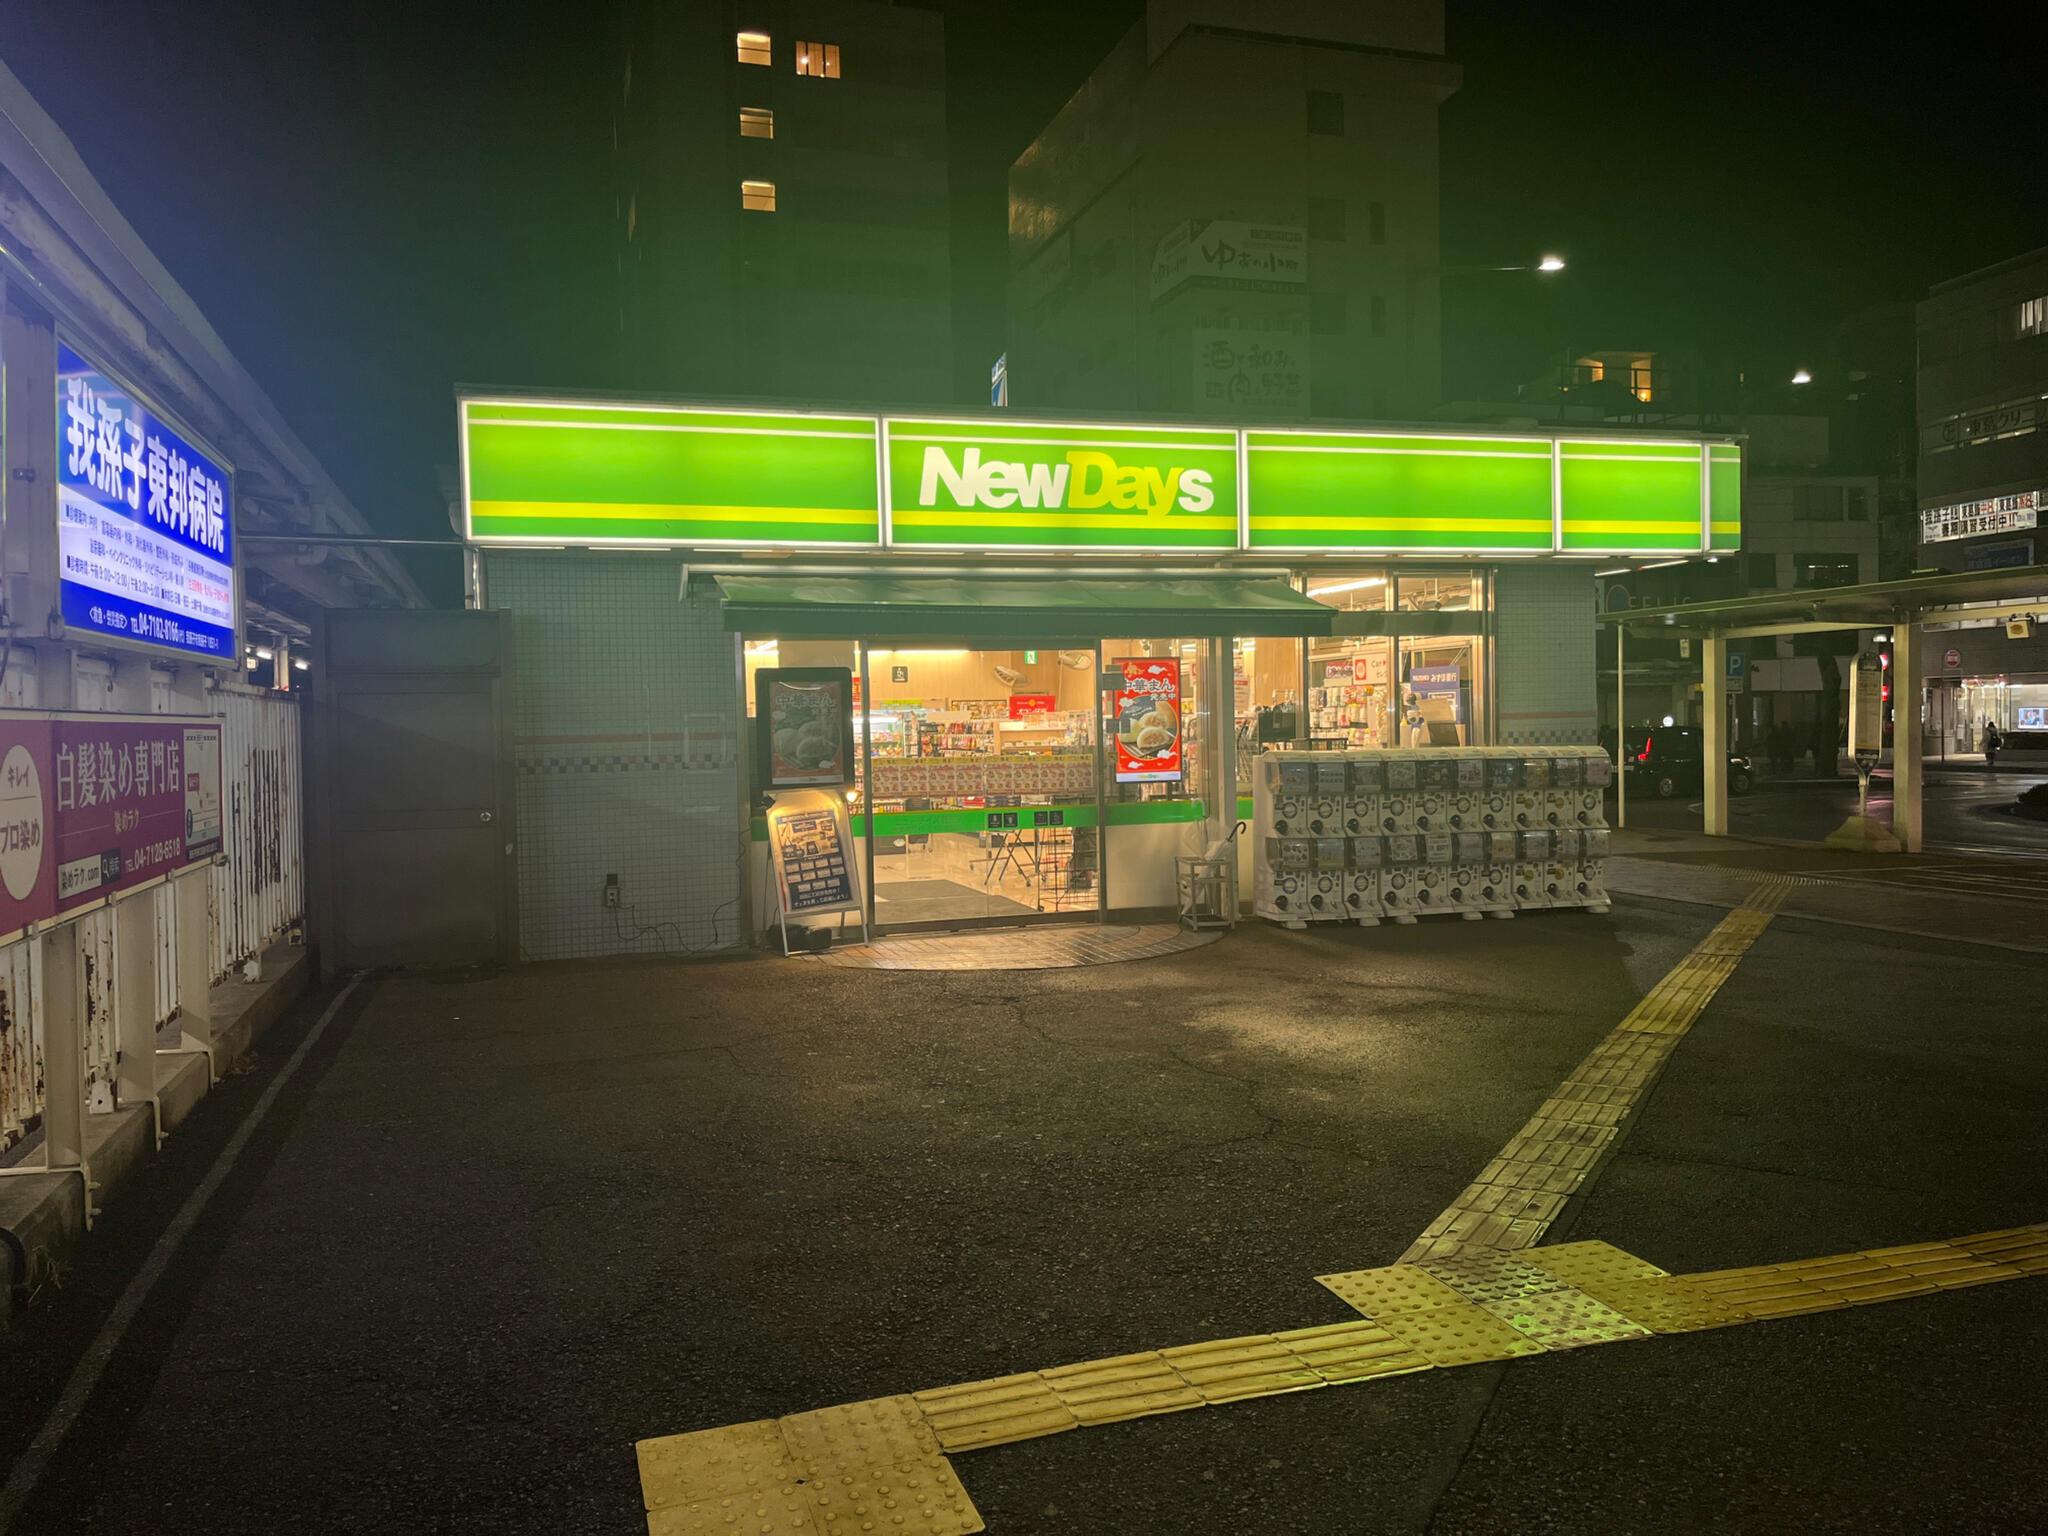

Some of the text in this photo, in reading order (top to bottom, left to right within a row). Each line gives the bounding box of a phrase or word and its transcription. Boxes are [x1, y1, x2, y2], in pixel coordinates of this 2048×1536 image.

[67, 378, 224, 553] 我孫子東邦病院
[919, 446, 1214, 516] NewDays
[1729, 655, 1742, 674] P
[8, 764, 30, 788] キレイ
[56, 740, 179, 811] 白髪染め専門店
[0, 817, 41, 855] プロ染め
